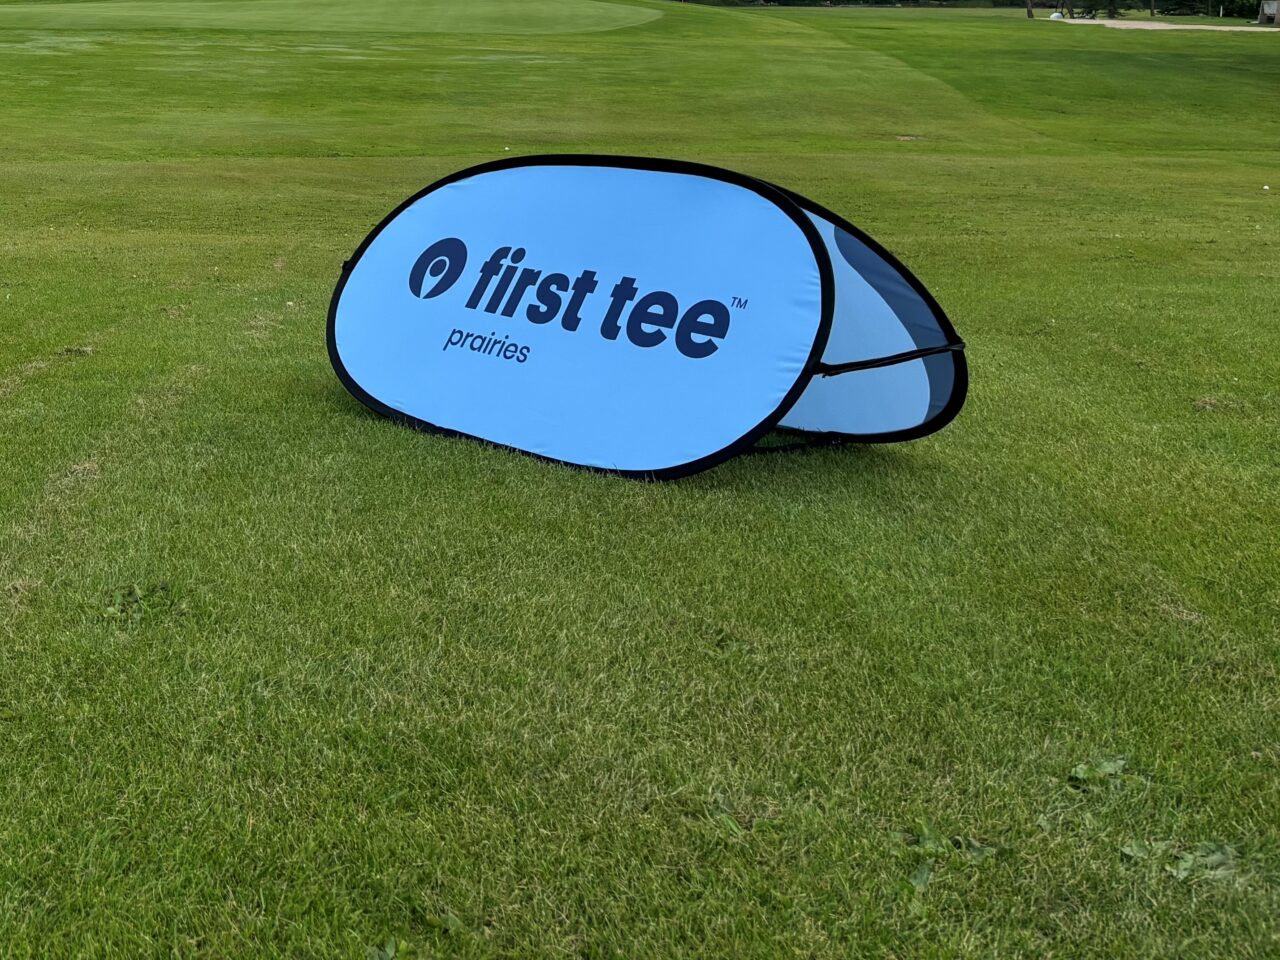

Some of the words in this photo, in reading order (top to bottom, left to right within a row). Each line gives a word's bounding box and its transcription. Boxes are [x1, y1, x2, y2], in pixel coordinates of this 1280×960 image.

[464, 246, 599, 332] first
[600, 276, 731, 359] tee
[442, 328, 531, 363] prairies
